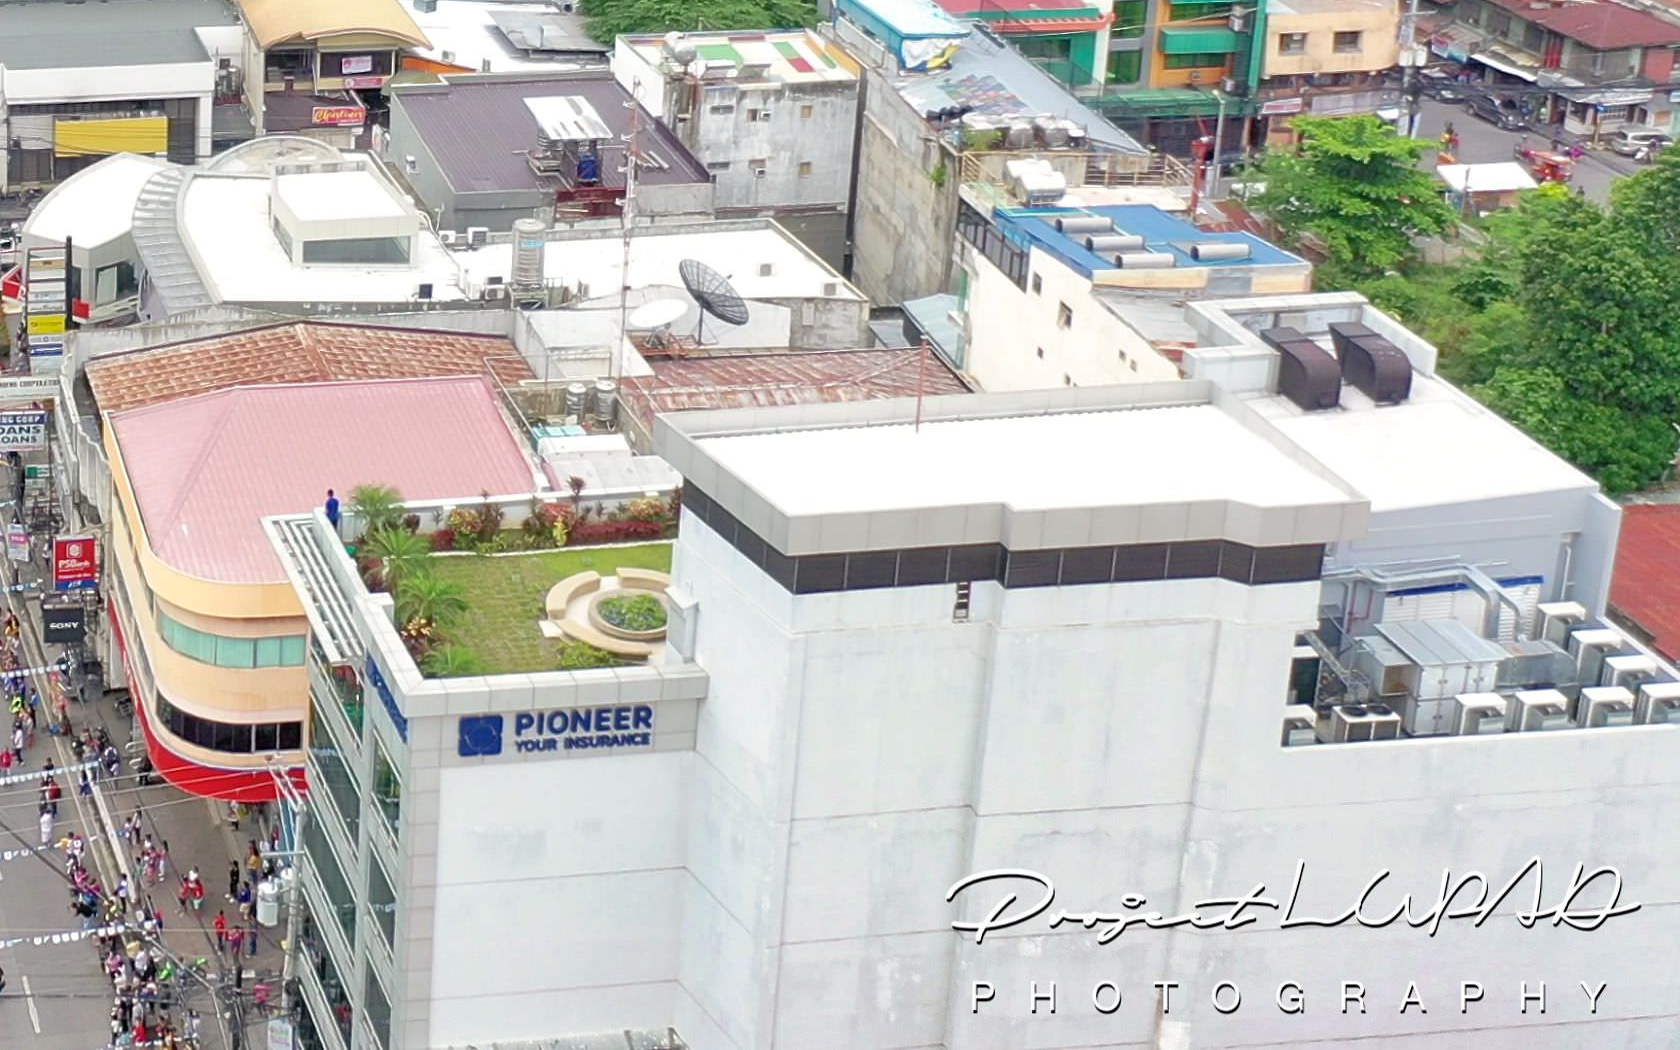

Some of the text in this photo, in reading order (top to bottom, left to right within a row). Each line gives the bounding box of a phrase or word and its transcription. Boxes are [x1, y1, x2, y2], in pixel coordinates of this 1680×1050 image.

[58, 559, 90, 568] PSBank
[49, 621, 79, 630] SONY
[515, 705, 653, 736] PIONEER
[515, 732, 651, 753] YOUR INSURANCE
